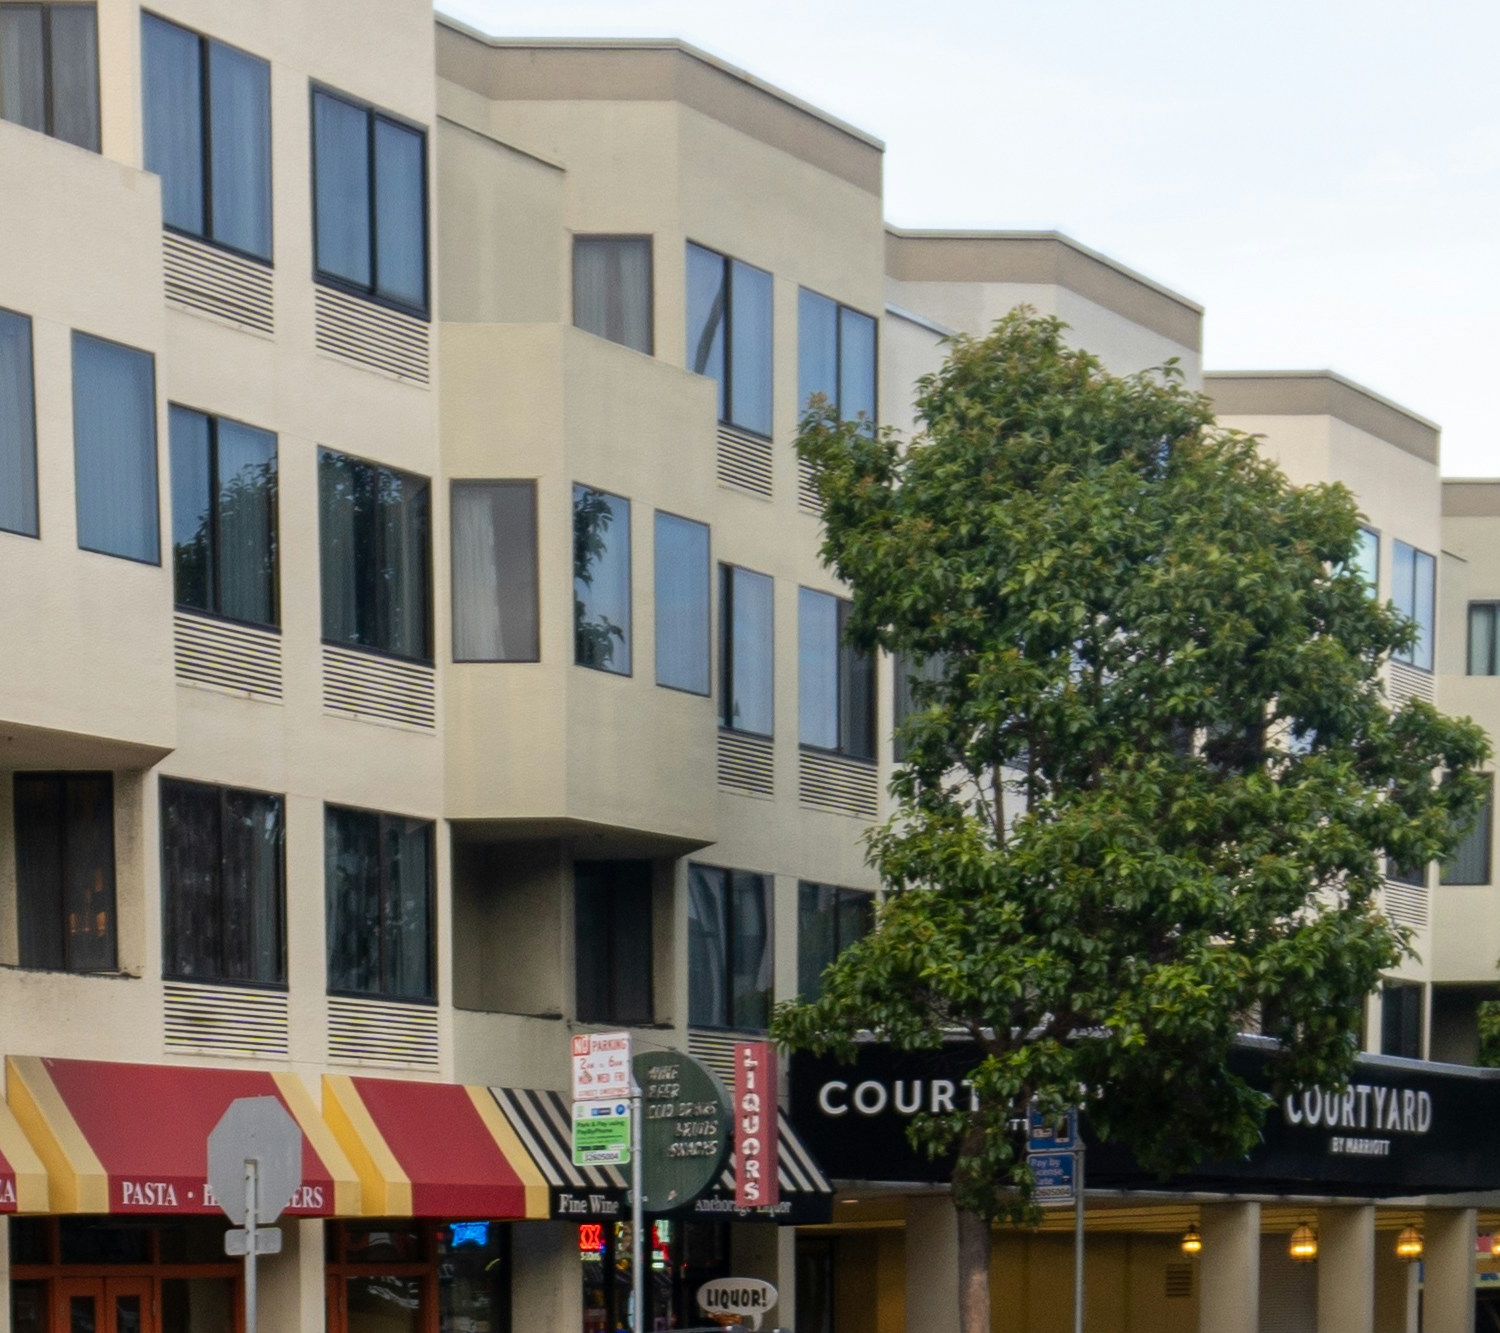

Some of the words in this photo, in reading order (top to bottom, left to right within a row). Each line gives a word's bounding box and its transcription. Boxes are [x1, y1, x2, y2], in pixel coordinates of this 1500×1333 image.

[592, 1038, 627, 1052] PARKING
[649, 1083, 680, 1098] BEER
[1287, 1083, 1433, 1133] COURTYARD
[742, 1048, 760, 1200] LIQUORS
[1332, 1136, 1344, 1152] BY
[1346, 1137, 1391, 1155] MARRIOTT
[1030, 1158, 1047, 1169] Pay
[1049, 1158, 1061, 1169] by
[122, 1181, 178, 1206] PASTA
[558, 1193, 588, 1213] Fine
[589, 1194, 620, 1214] Wine
[706, 1287, 767, 1308] LIQUOR!
